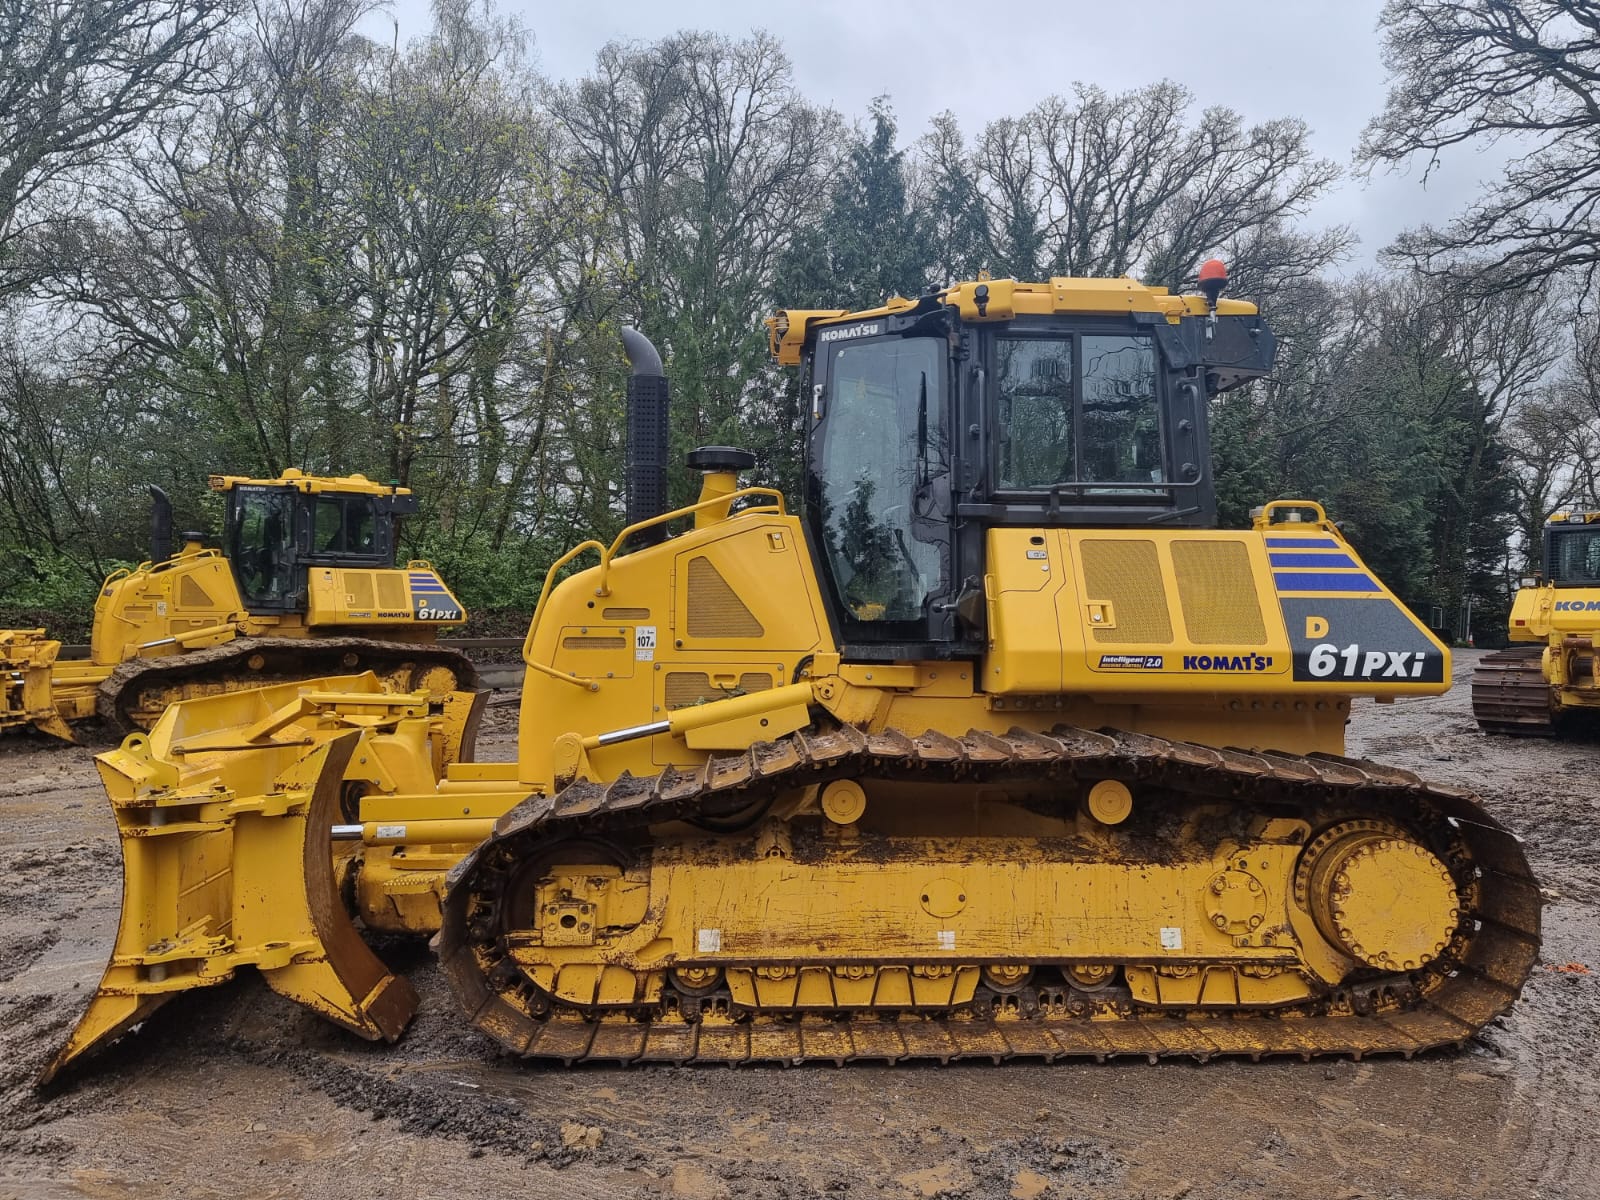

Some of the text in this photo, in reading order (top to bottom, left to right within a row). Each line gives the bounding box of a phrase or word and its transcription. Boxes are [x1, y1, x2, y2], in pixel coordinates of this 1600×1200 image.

[821, 323, 879, 342] KOMATSU
[418, 599, 428, 608] D
[418, 608, 456, 620] 61PXi
[1305, 616, 1330, 639] D
[637, 636, 650, 647] 107
[1146, 658, 1162, 667] 2.0
[1308, 643, 1426, 677] 61PXi
